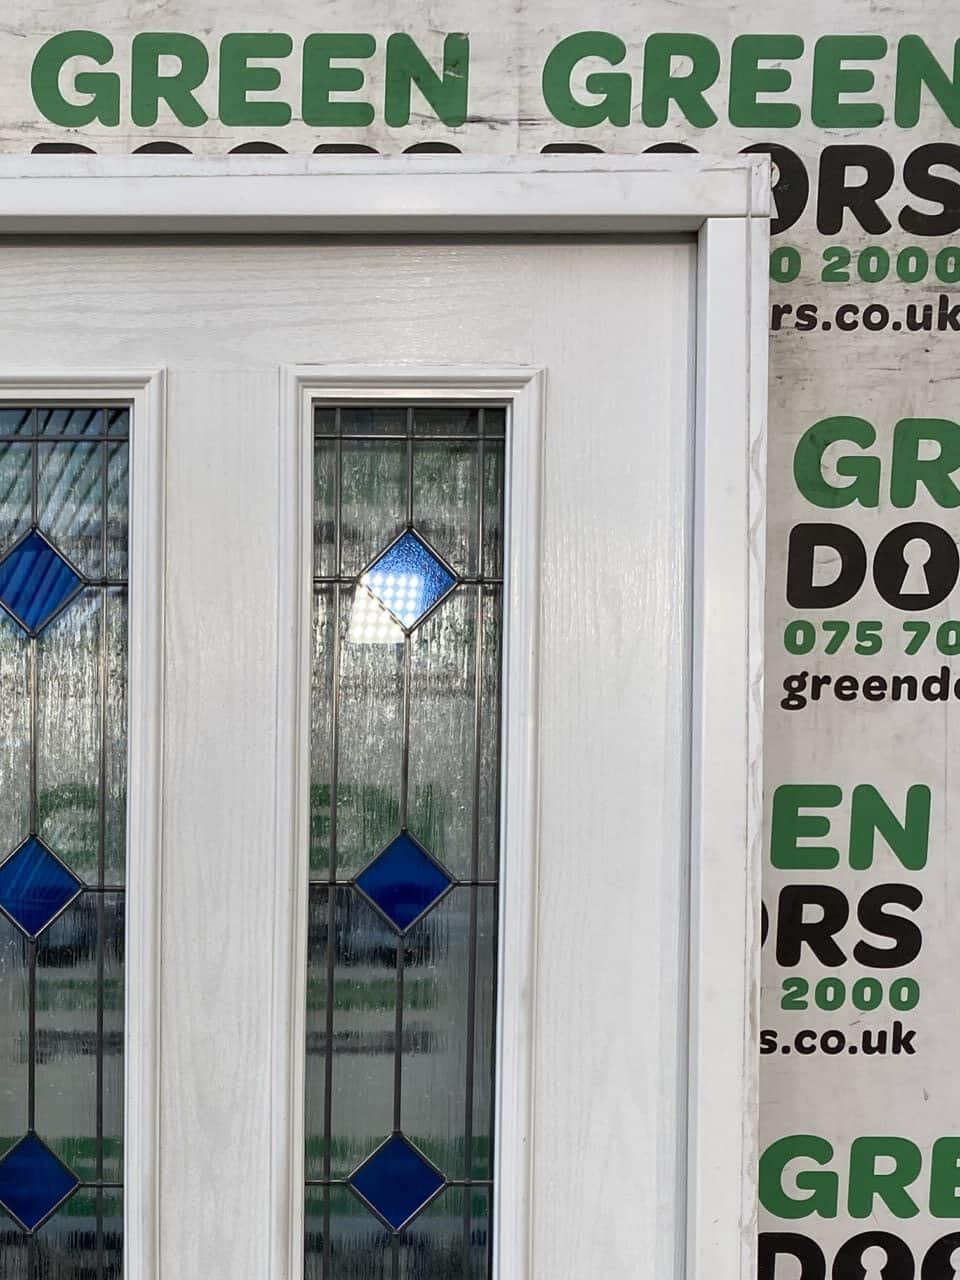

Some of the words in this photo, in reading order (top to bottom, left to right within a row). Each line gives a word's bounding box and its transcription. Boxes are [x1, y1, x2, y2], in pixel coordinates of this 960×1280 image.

[30, 30, 469, 128] GREEN
[542, 31, 960, 129] GREEN
[821, 246, 960, 284] 2000
[784, 620, 883, 656] 075
[780, 666, 960, 710] greend
[781, 977, 920, 1012] 2000
